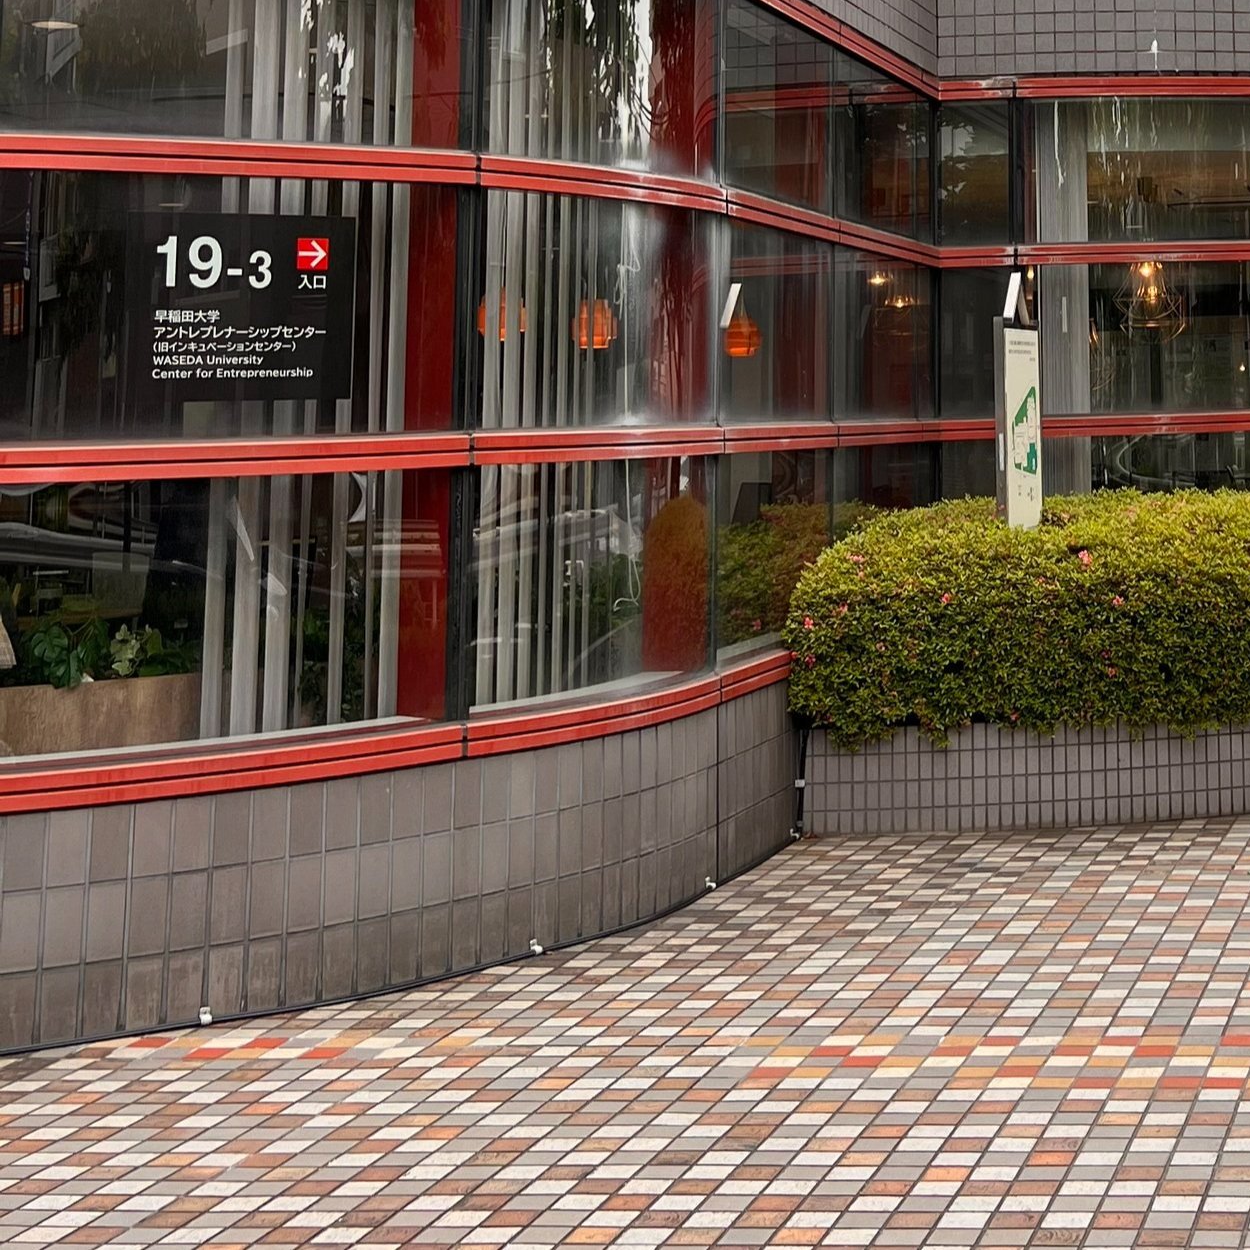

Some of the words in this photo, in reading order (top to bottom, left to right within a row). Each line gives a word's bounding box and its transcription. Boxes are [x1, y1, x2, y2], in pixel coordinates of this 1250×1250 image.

[156, 235, 272, 289] 19-3
[298, 274, 327, 289] 入口
[154, 309, 221, 323] 早稲田大学
[153, 325, 327, 339] アントレプレナーシップセンター
[153, 355, 204, 366] WASEDA
[206, 354, 264, 366] University
[152, 368, 193, 379] Center
[196, 368, 214, 379] for
[216, 367, 314, 379] Entrepreneurship
